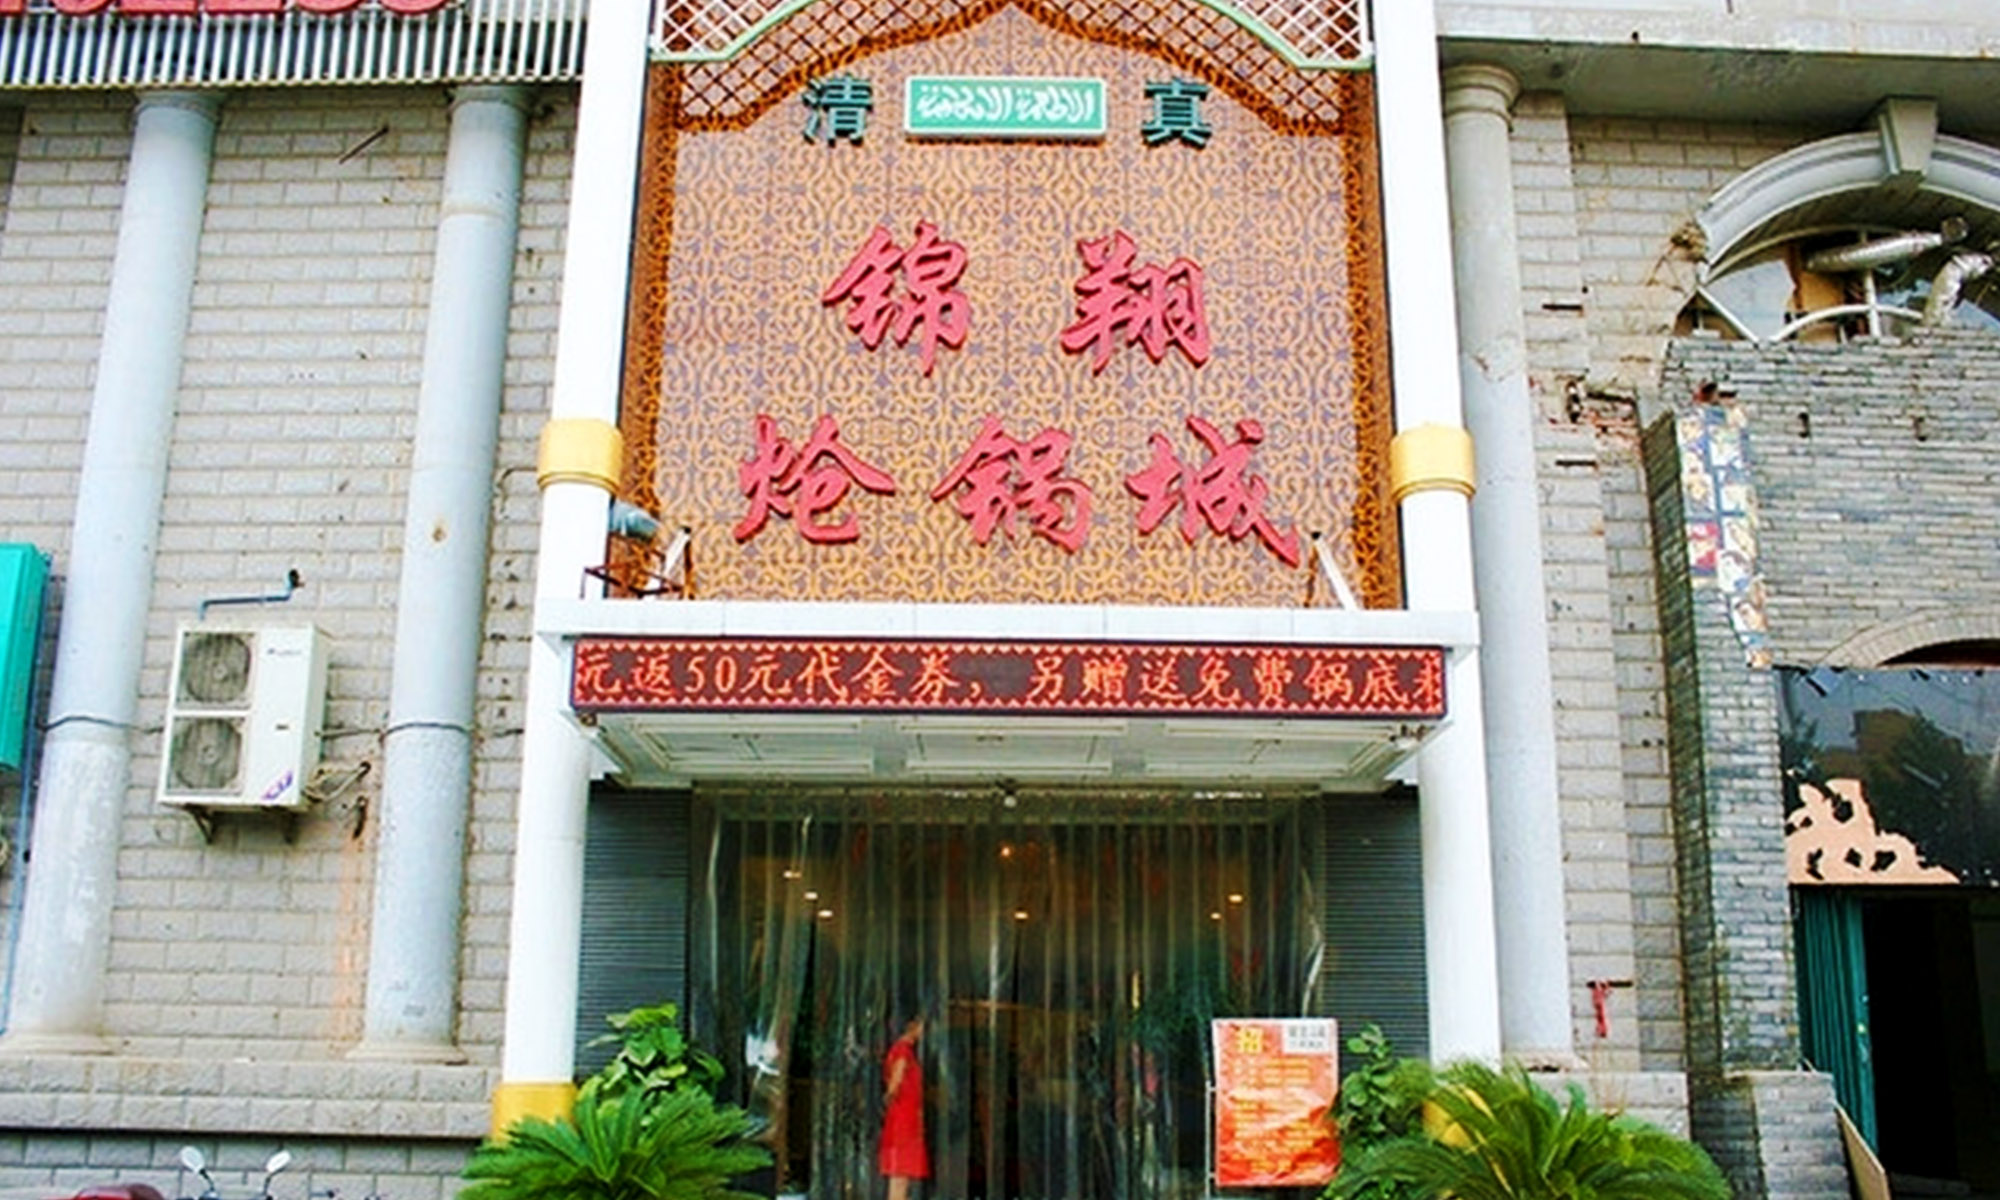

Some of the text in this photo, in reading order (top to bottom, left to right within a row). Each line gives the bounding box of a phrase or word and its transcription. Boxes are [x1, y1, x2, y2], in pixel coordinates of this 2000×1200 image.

[802, 72, 873, 146] 清
[1141, 77, 1211, 148] 真
[822, 219, 1209, 377] 锦翔
[733, 413, 1299, 569] 炝锅城
